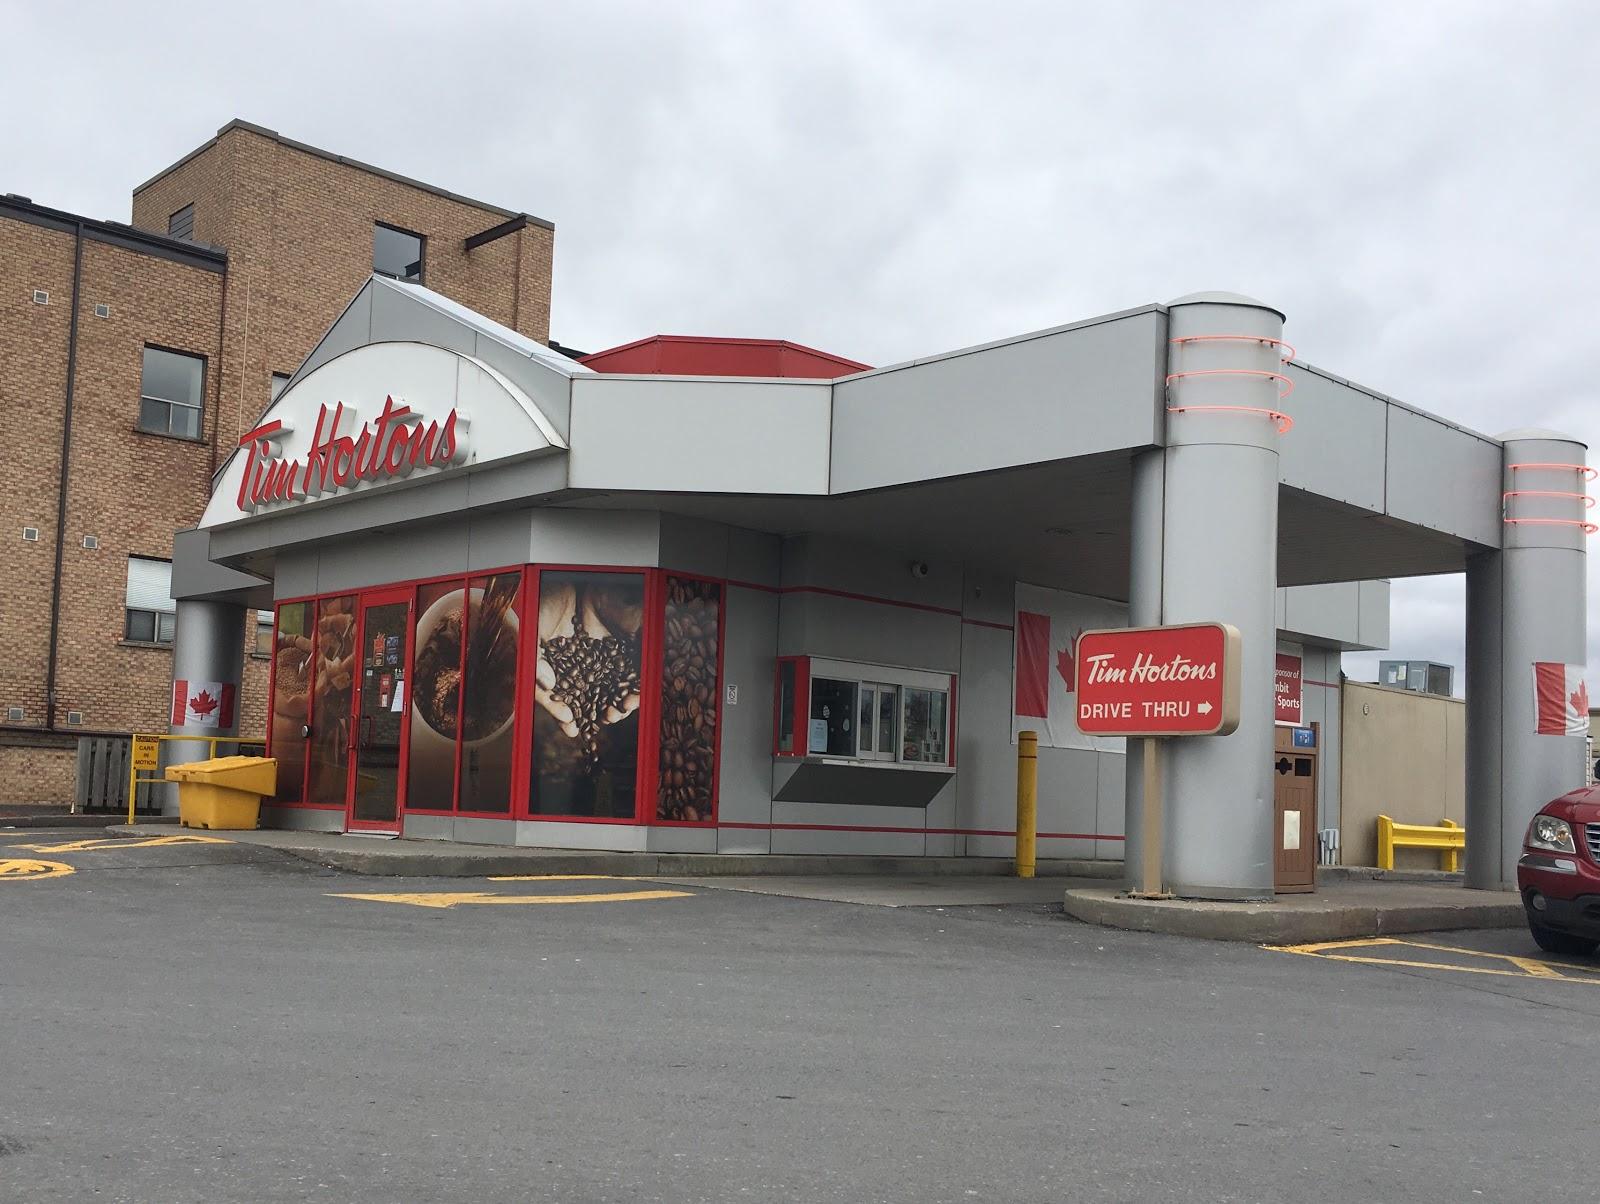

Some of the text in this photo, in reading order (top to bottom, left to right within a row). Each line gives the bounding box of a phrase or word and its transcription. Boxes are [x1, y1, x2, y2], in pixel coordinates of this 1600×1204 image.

[236, 394, 458, 512] Tim Hortons
[1086, 652, 1217, 685] Tim Hortons
[1275, 669, 1292, 678] ponsor
[1080, 701, 1190, 719] DRIVE THRU
[1277, 695, 1300, 709] Sports
